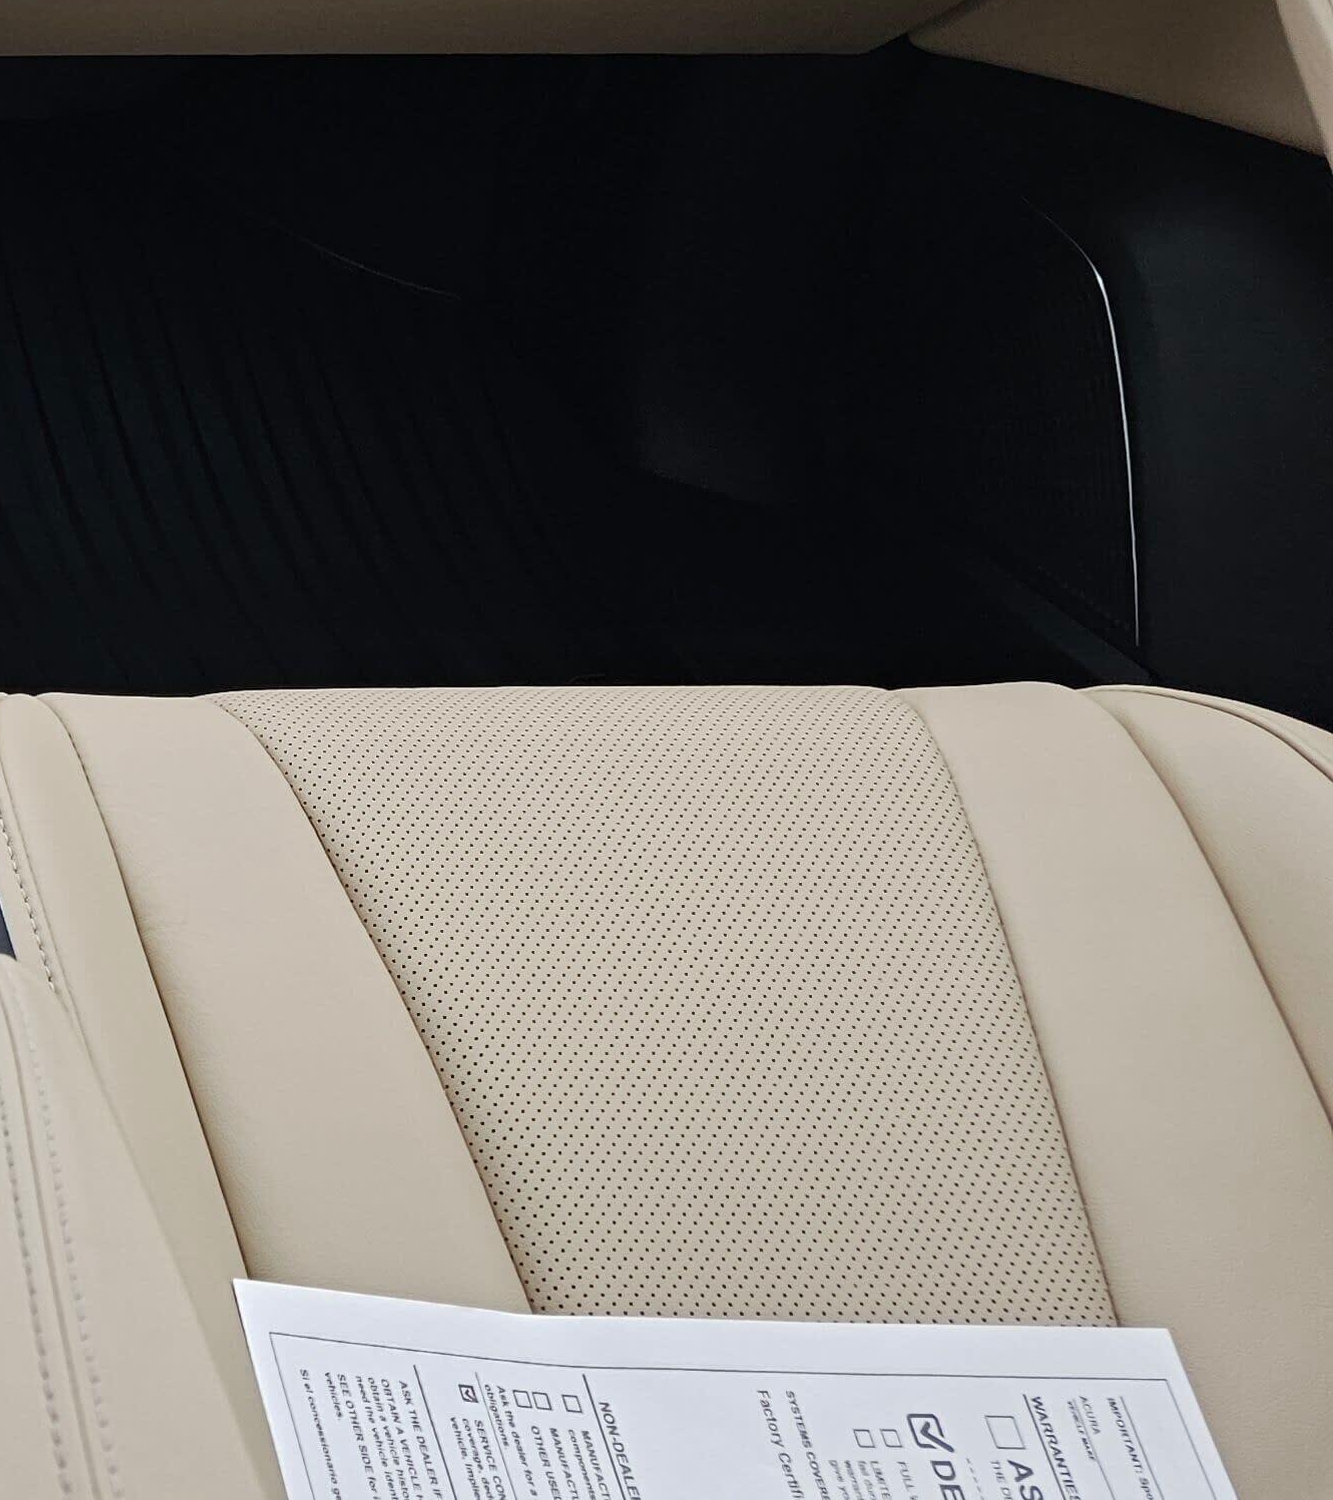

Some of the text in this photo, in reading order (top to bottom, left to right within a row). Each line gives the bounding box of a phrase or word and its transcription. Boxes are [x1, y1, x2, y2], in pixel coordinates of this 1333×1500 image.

[300, 1369, 311, 1380] Si
[304, 1383, 314, 1393] el
[324, 1371, 345, 1420] vehicles.
[307, 1396, 340, 1484] concessionario
[337, 1373, 380, 1492] SEE OTHER SIDE for
[356, 1375, 371, 1402] need
[365, 1406, 377, 1423] the
[372, 1427, 390, 1467] vehicle
[368, 1377, 386, 1412] obtain
[382, 1425, 402, 1465] vehicle
[381, 1378, 421, 1490] OBTAIN A VEHICLE
[399, 1380, 443, 1499] ASK THE DEALER IF
[484, 1383, 511, 1449] obligations.
[496, 1385, 511, 1407] Ask
[505, 1410, 517, 1427] the
[511, 1430, 529, 1466] dealer
[523, 1469, 536, 1486] for
[755, 1390, 788, 1447] Factory
[785, 1390, 813, 1448] SYSTEMS
[1079, 1395, 1102, 1434] ACURA
[1107, 1397, 1144, 1472] IMPORTANT:
[474, 1419, 499, 1471] SERVICE
[530, 1425, 552, 1467] OTHER
[580, 1429, 611, 1500] MANUFACT
[991, 1460, 1007, 1481] THE
[896, 1460, 915, 1490] FULL
[1007, 1460, 1045, 1500] AS
